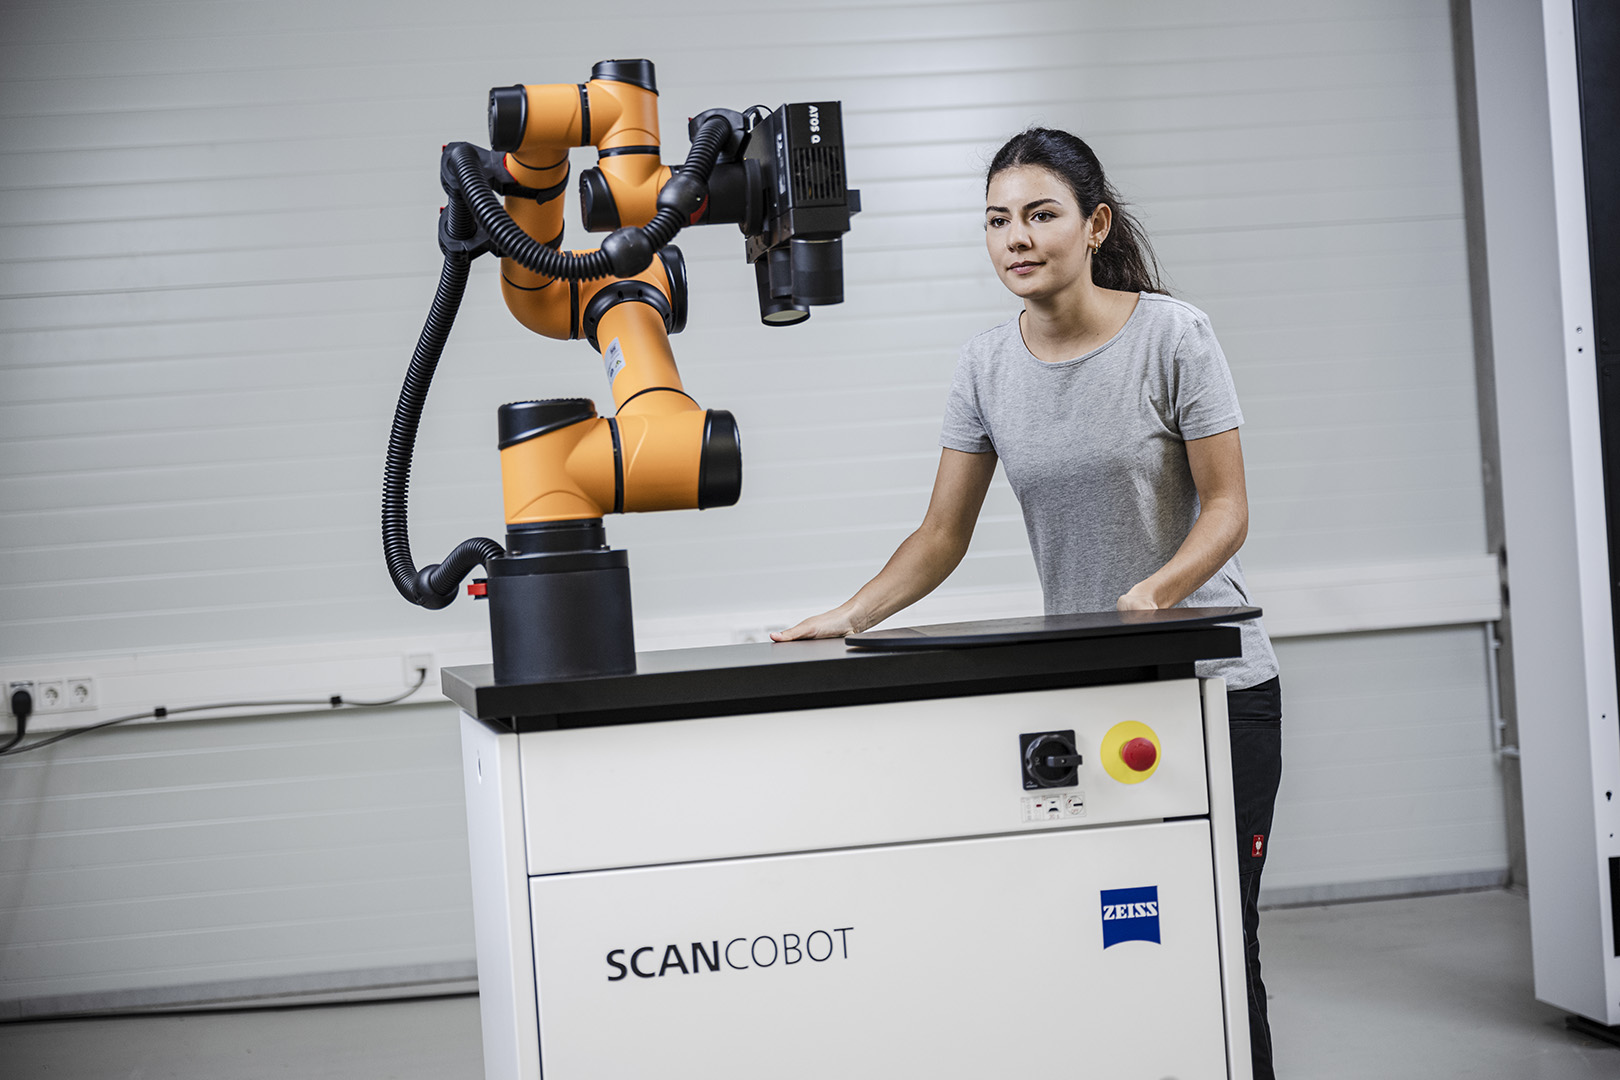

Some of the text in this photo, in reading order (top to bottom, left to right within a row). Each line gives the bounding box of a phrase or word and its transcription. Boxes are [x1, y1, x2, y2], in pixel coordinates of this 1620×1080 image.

[808, 105, 821, 145] ATOS Q
[1103, 901, 1158, 921] ZEISS
[606, 927, 855, 982] SCANCOBOT
